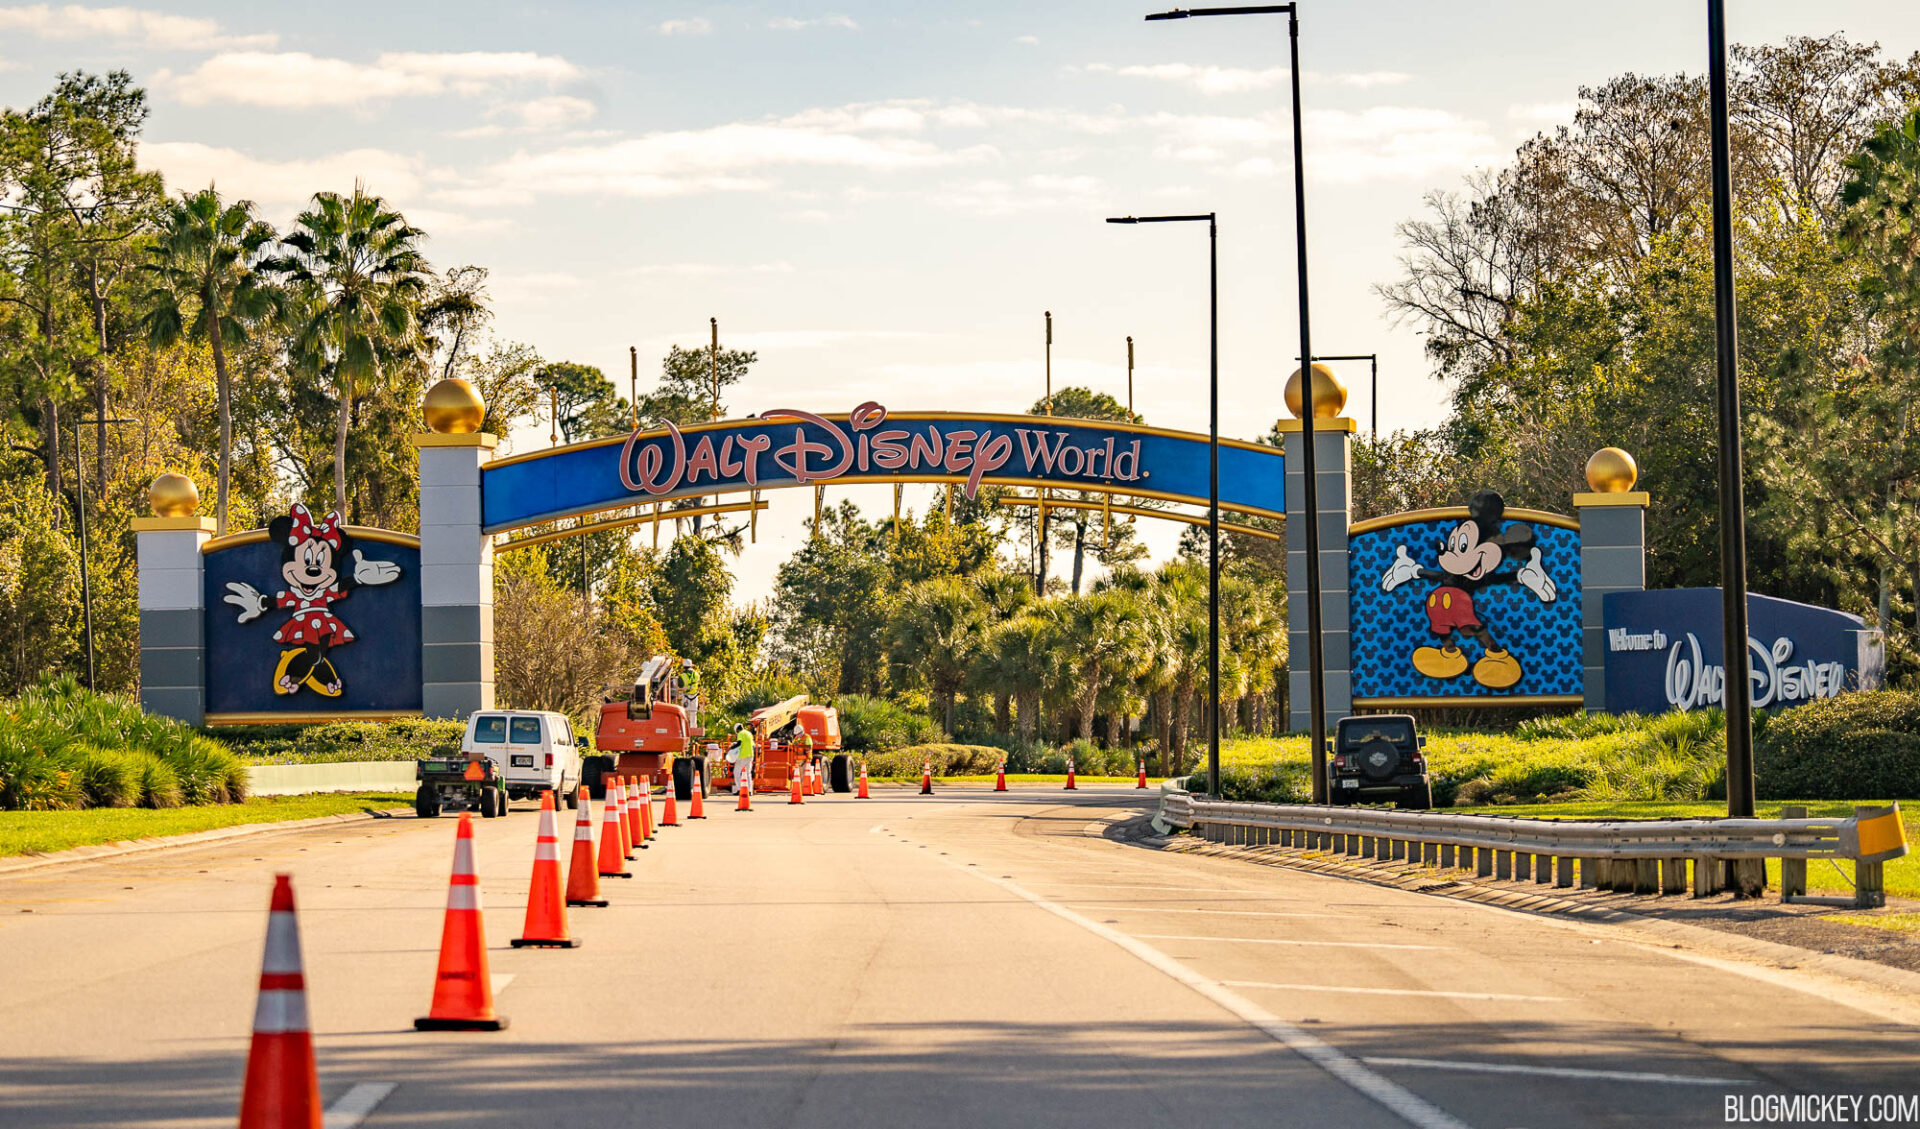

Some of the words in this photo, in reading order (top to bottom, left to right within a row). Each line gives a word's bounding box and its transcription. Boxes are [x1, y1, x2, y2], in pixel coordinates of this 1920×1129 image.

[619, 417, 771, 495] WALT
[760, 401, 1013, 500] DISNEY
[1608, 628, 1653, 651] Welcome
[1653, 629, 1668, 650] to
